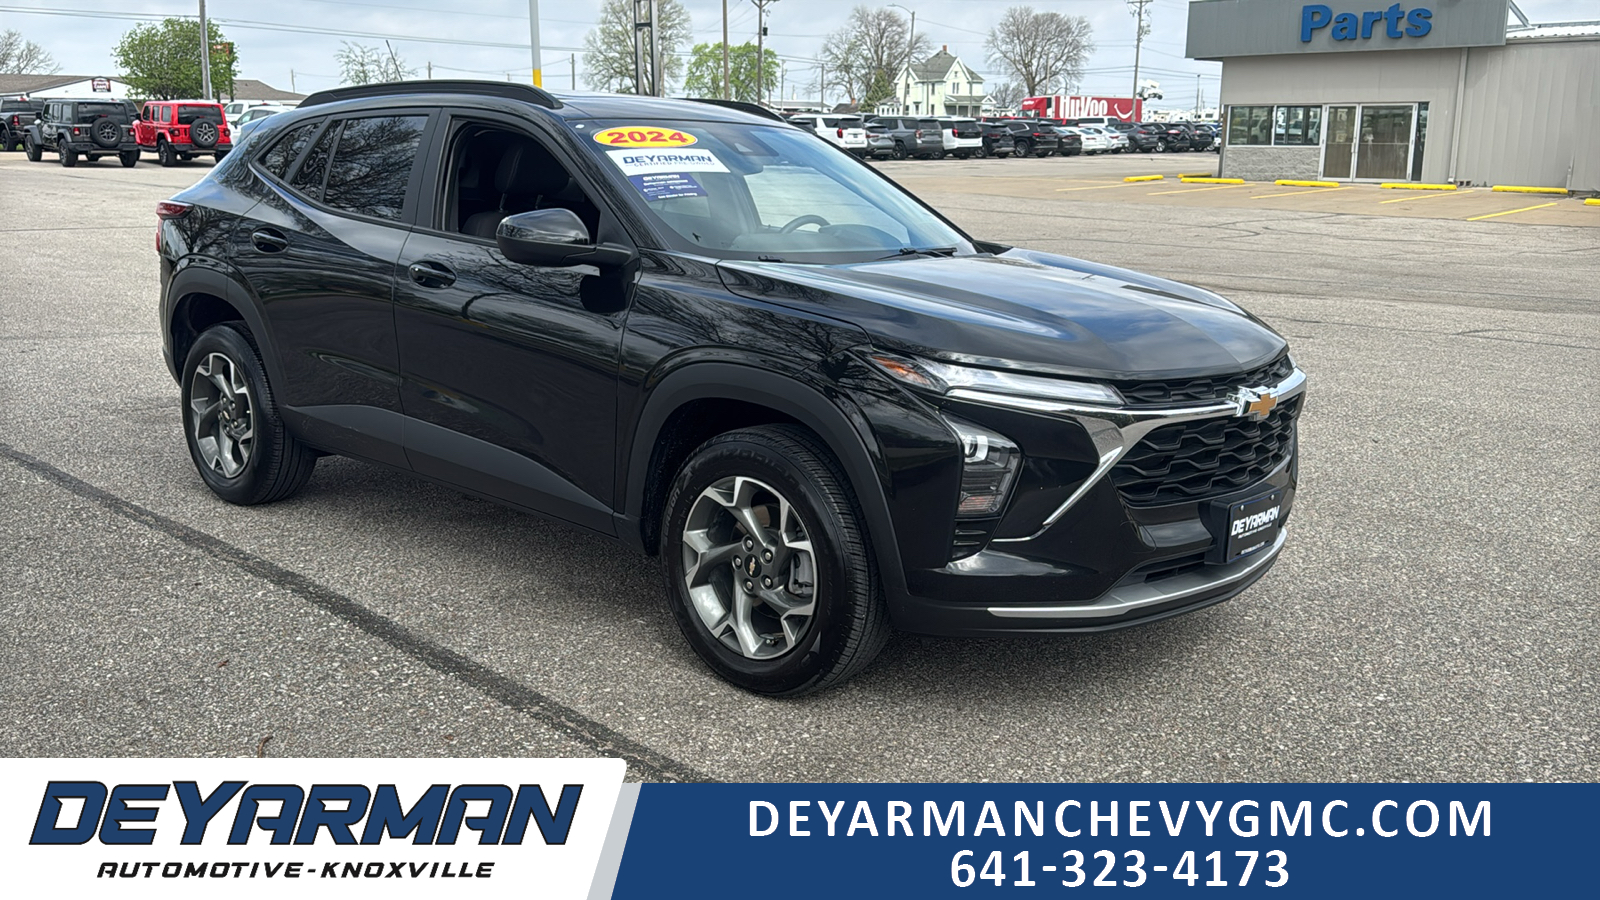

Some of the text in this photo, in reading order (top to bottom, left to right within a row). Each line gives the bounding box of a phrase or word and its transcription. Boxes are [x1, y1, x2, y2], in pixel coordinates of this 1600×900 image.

[1300, 3, 1433, 42] Parts
[607, 131, 688, 144] 2024
[623, 155, 712, 164] DEYARMAN
[1231, 505, 1280, 537] DEYARMAN
